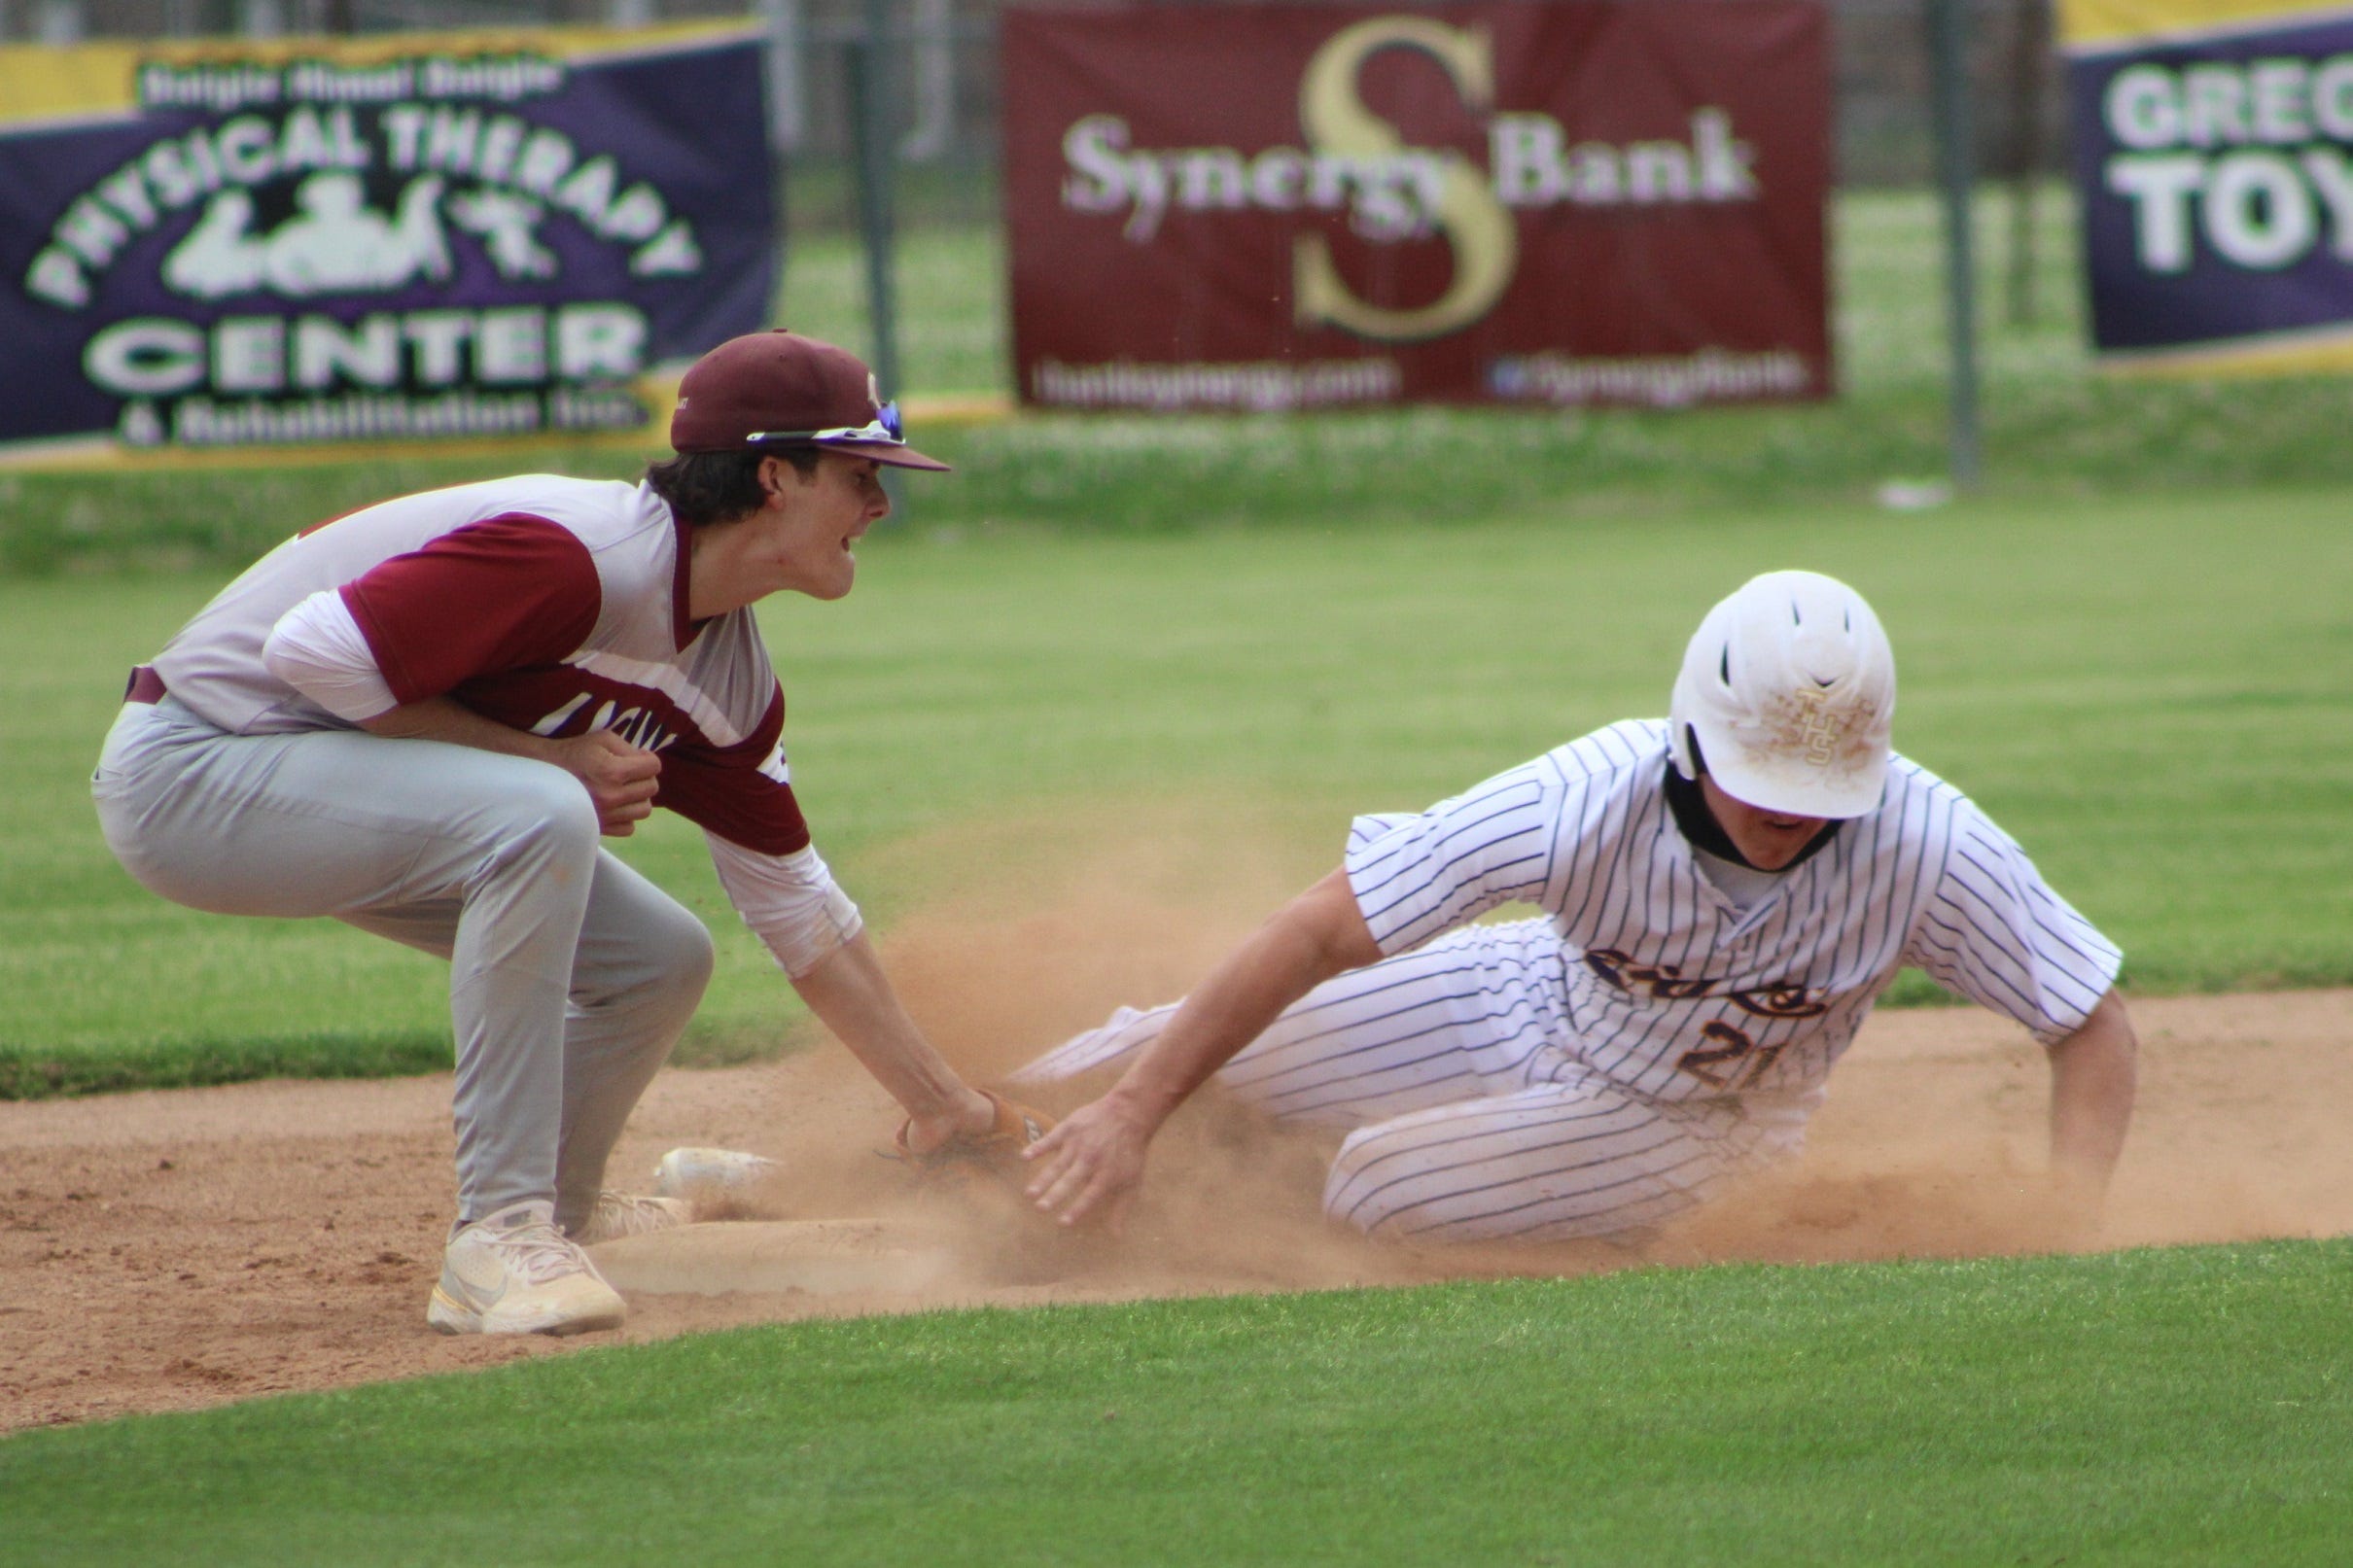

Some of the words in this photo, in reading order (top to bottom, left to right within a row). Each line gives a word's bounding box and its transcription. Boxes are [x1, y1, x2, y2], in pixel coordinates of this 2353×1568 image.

[25, 108, 368, 307] PHYSICAL
[386, 106, 700, 275] THERAPY
[1063, 116, 1455, 242] Synergy
[1492, 108, 1756, 205] Bank
[85, 304, 649, 391] CENTER
